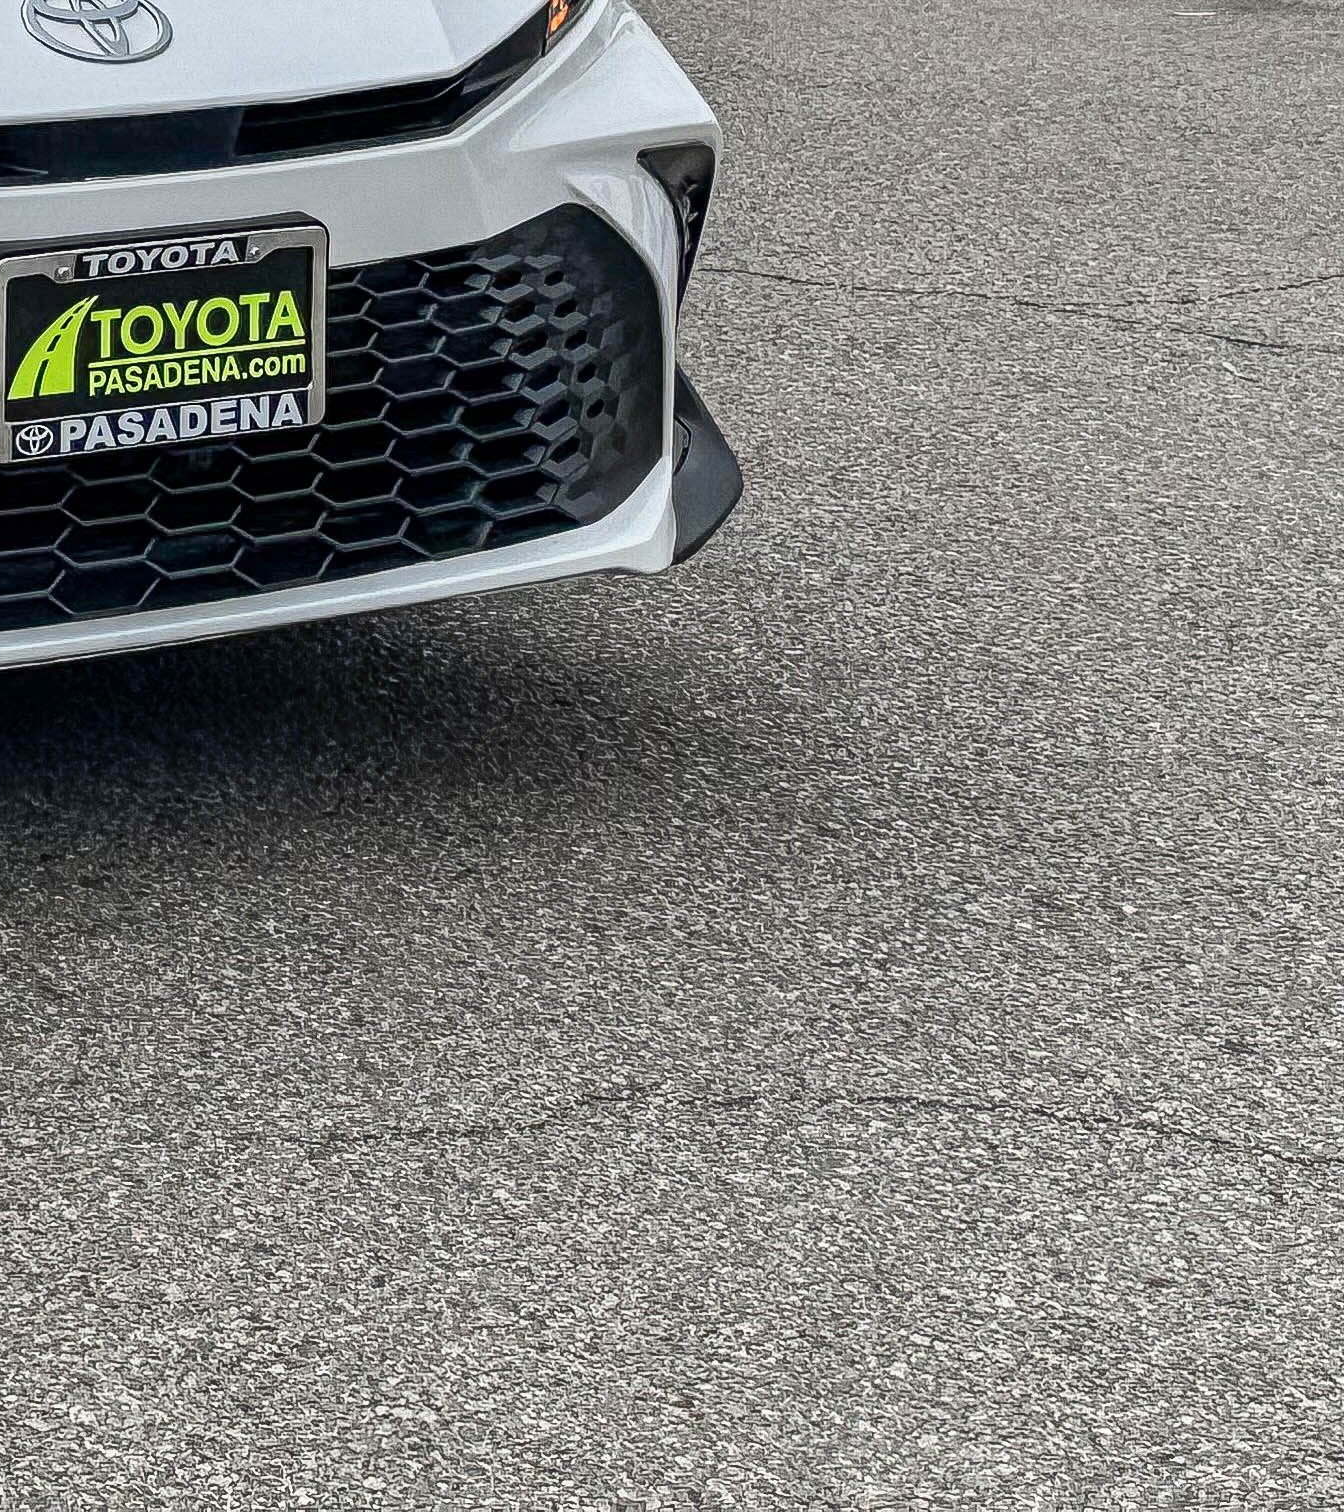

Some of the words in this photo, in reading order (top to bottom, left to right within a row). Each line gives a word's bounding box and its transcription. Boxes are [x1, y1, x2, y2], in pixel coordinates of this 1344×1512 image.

[82, 240, 239, 277] TOYOTA
[90, 290, 305, 359] TOYOTA
[89, 353, 306, 398] PASADENA.com
[60, 393, 303, 453] PASADENA
